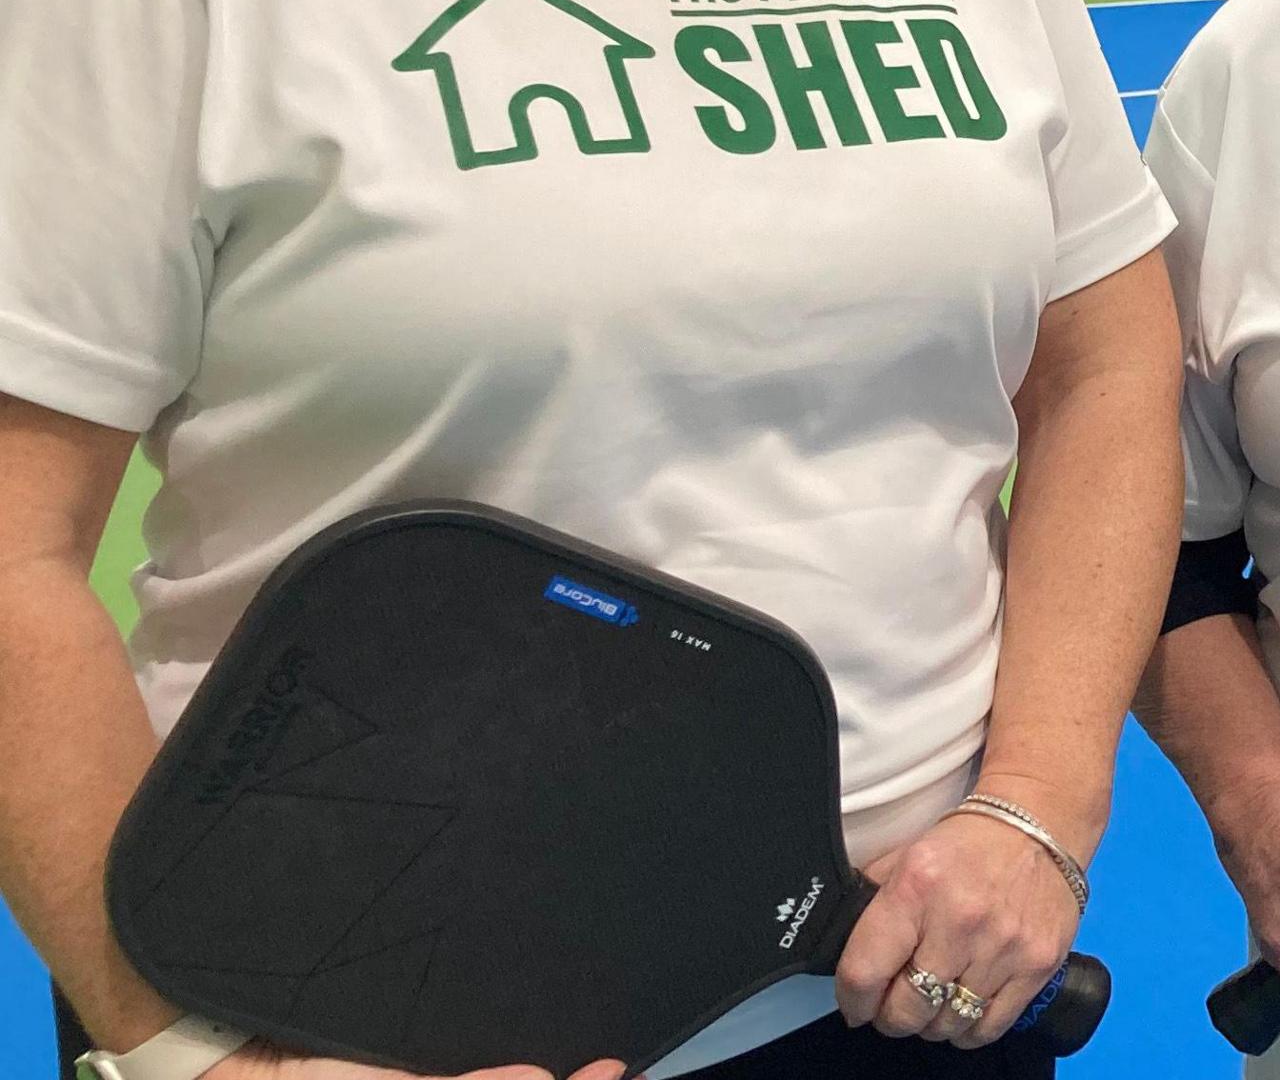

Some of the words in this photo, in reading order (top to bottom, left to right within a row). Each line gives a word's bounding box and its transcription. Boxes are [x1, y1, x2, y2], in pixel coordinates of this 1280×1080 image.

[673, 17, 1008, 156] SHED
[553, 583, 619, 616] BluCore
[779, 883, 825, 949] DIADEM
[1013, 960, 1069, 1032] DIADE
